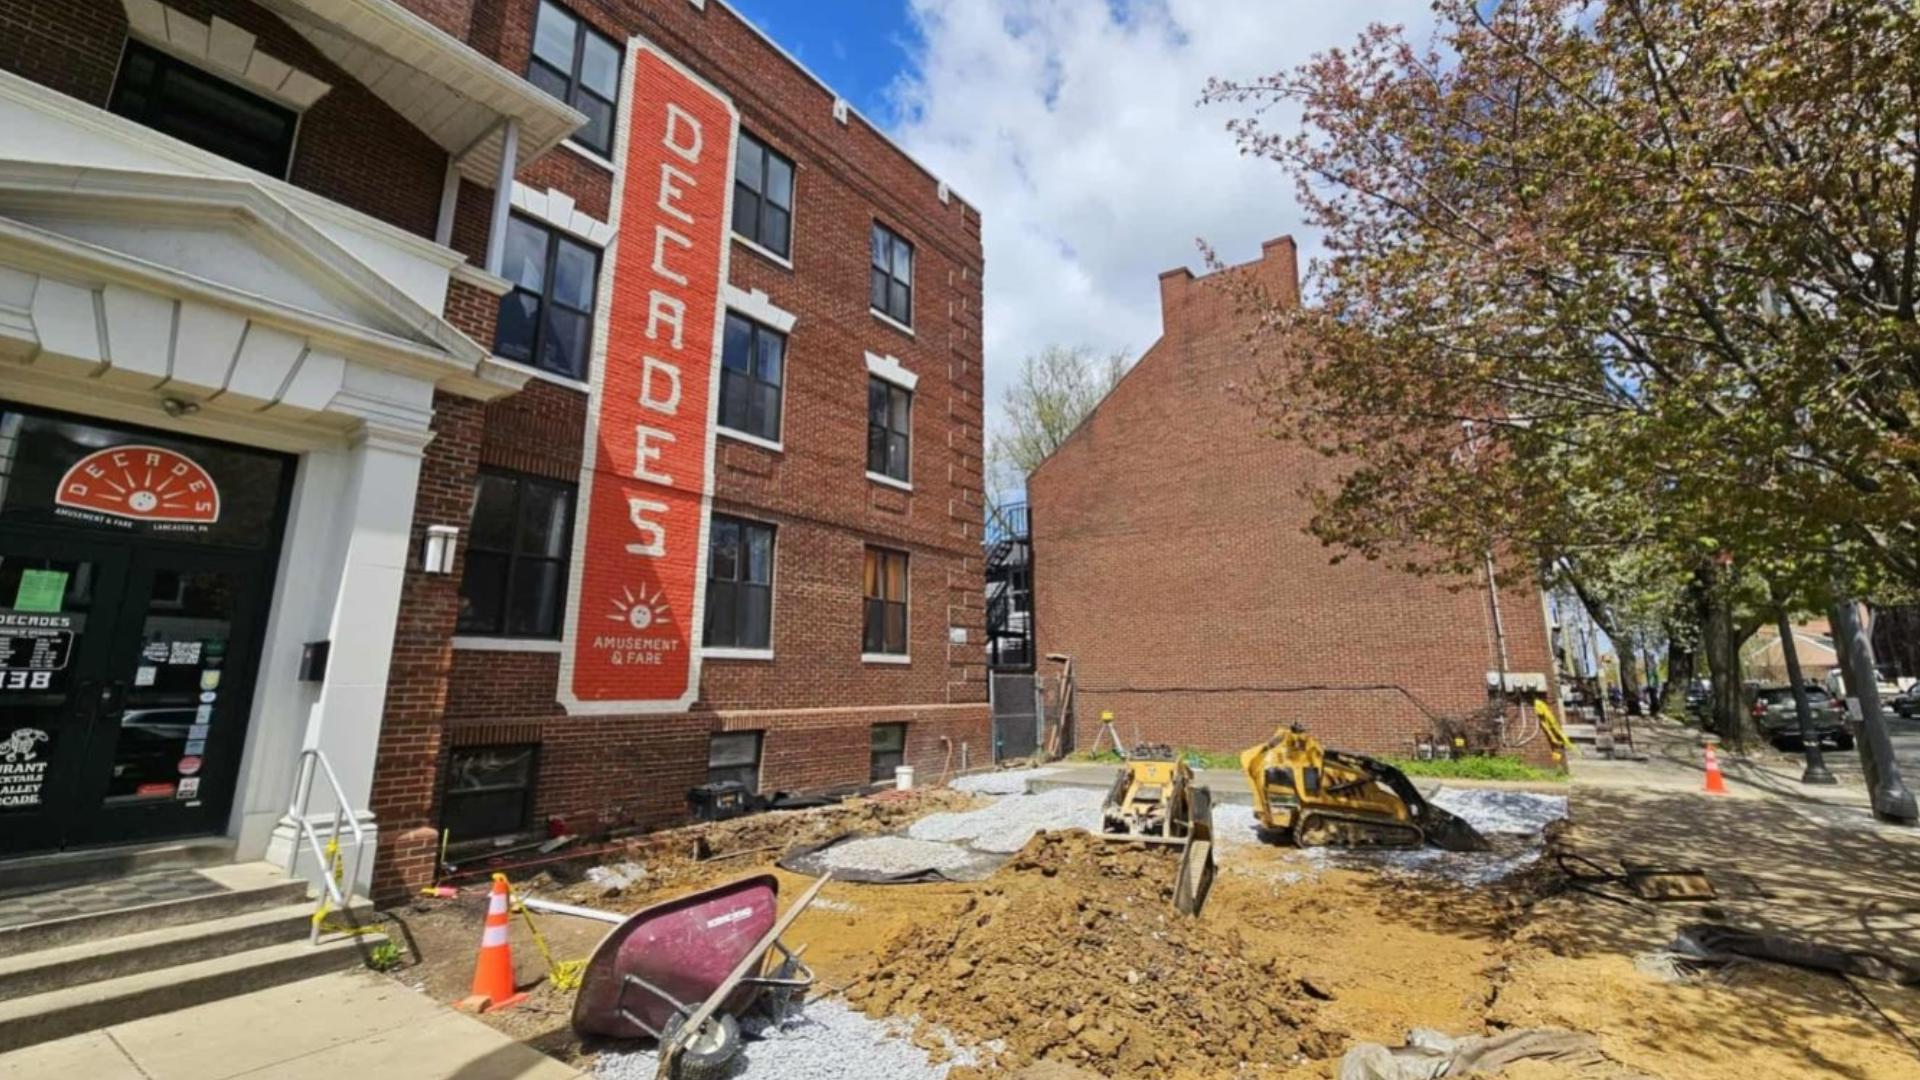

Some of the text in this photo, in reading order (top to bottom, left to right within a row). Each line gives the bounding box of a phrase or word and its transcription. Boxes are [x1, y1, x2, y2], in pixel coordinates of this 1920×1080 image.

[624, 102, 704, 558] DECADES
[67, 452, 212, 512] DECADES
[54, 507, 104, 523] AMUSEMENT
[113, 519, 133, 529] FARE
[593, 635, 679, 651] AMUSEMENT
[610, 650, 664, 665] & FARE
